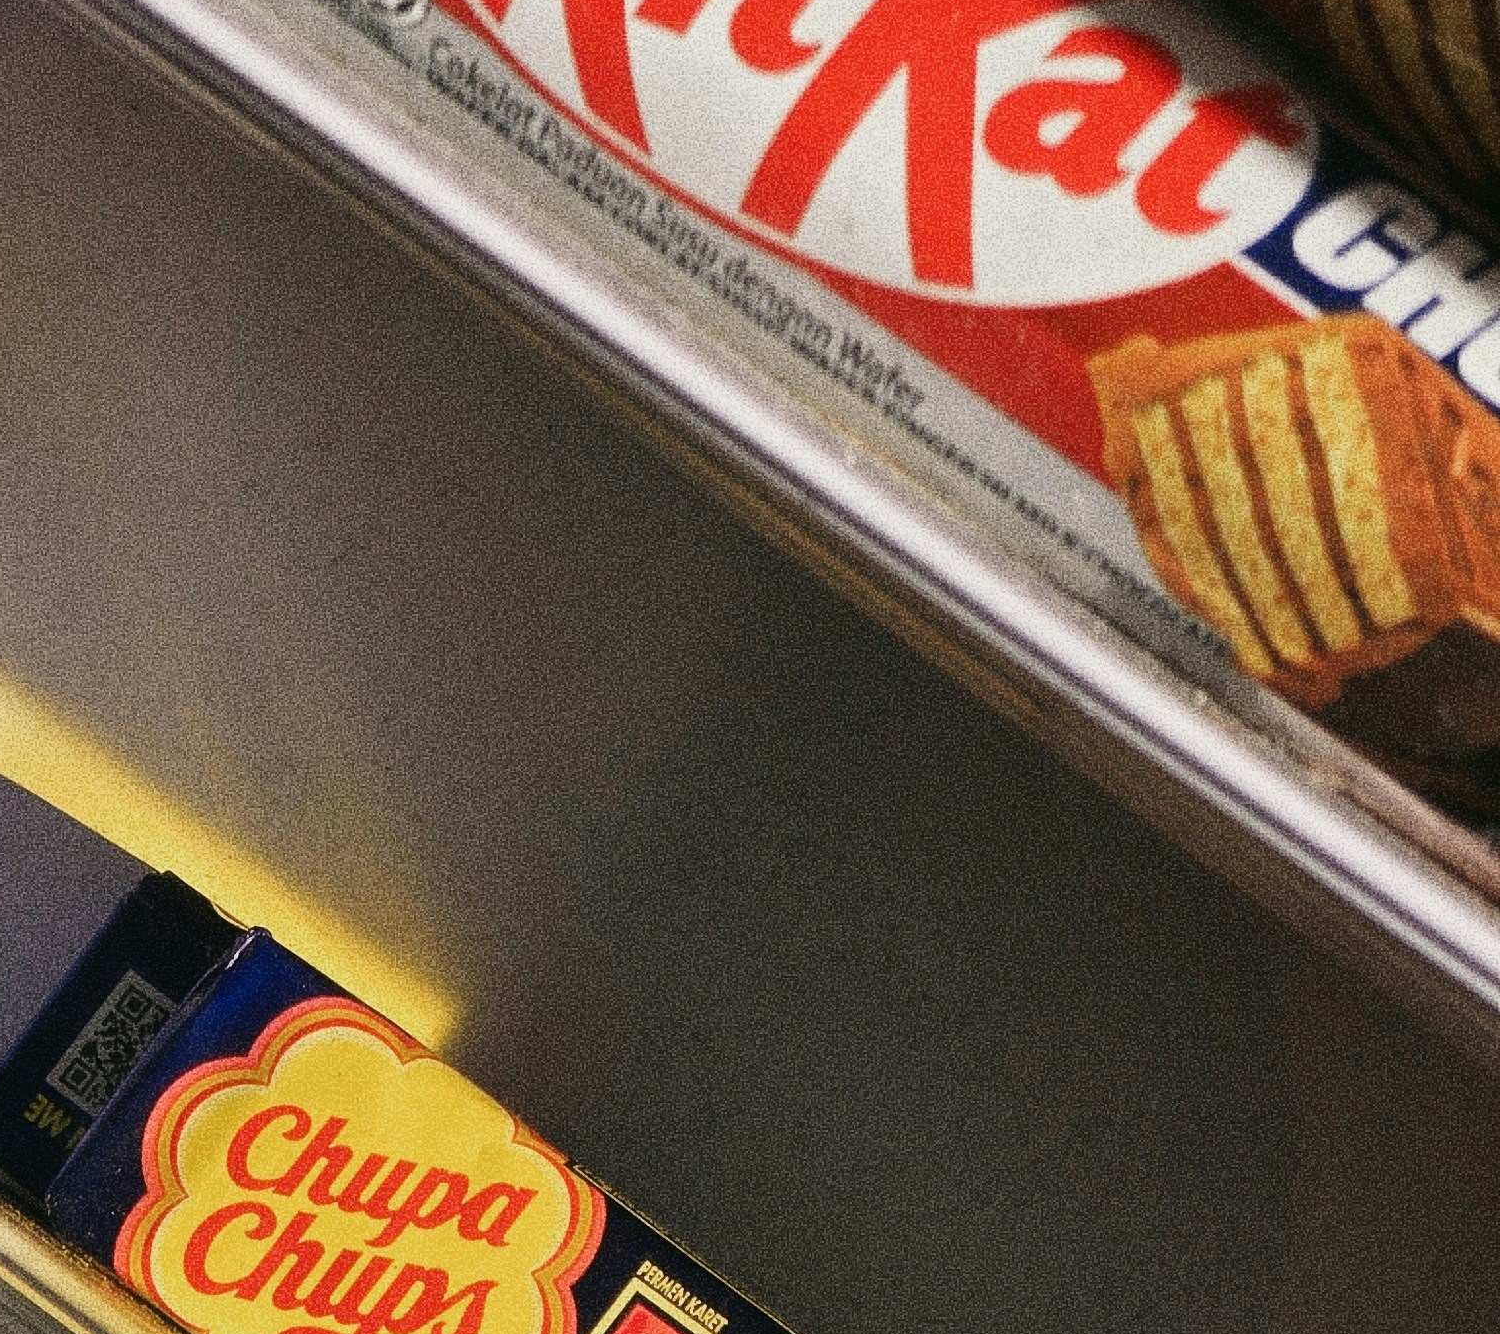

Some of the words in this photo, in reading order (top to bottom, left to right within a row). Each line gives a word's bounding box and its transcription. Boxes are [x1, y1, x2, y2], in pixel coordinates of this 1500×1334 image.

[23, 1094, 70, 1138] ME
[226, 1103, 538, 1248] Chupa
[637, 1260, 690, 1304] PERMEN
[685, 1297, 727, 1333] KARET
